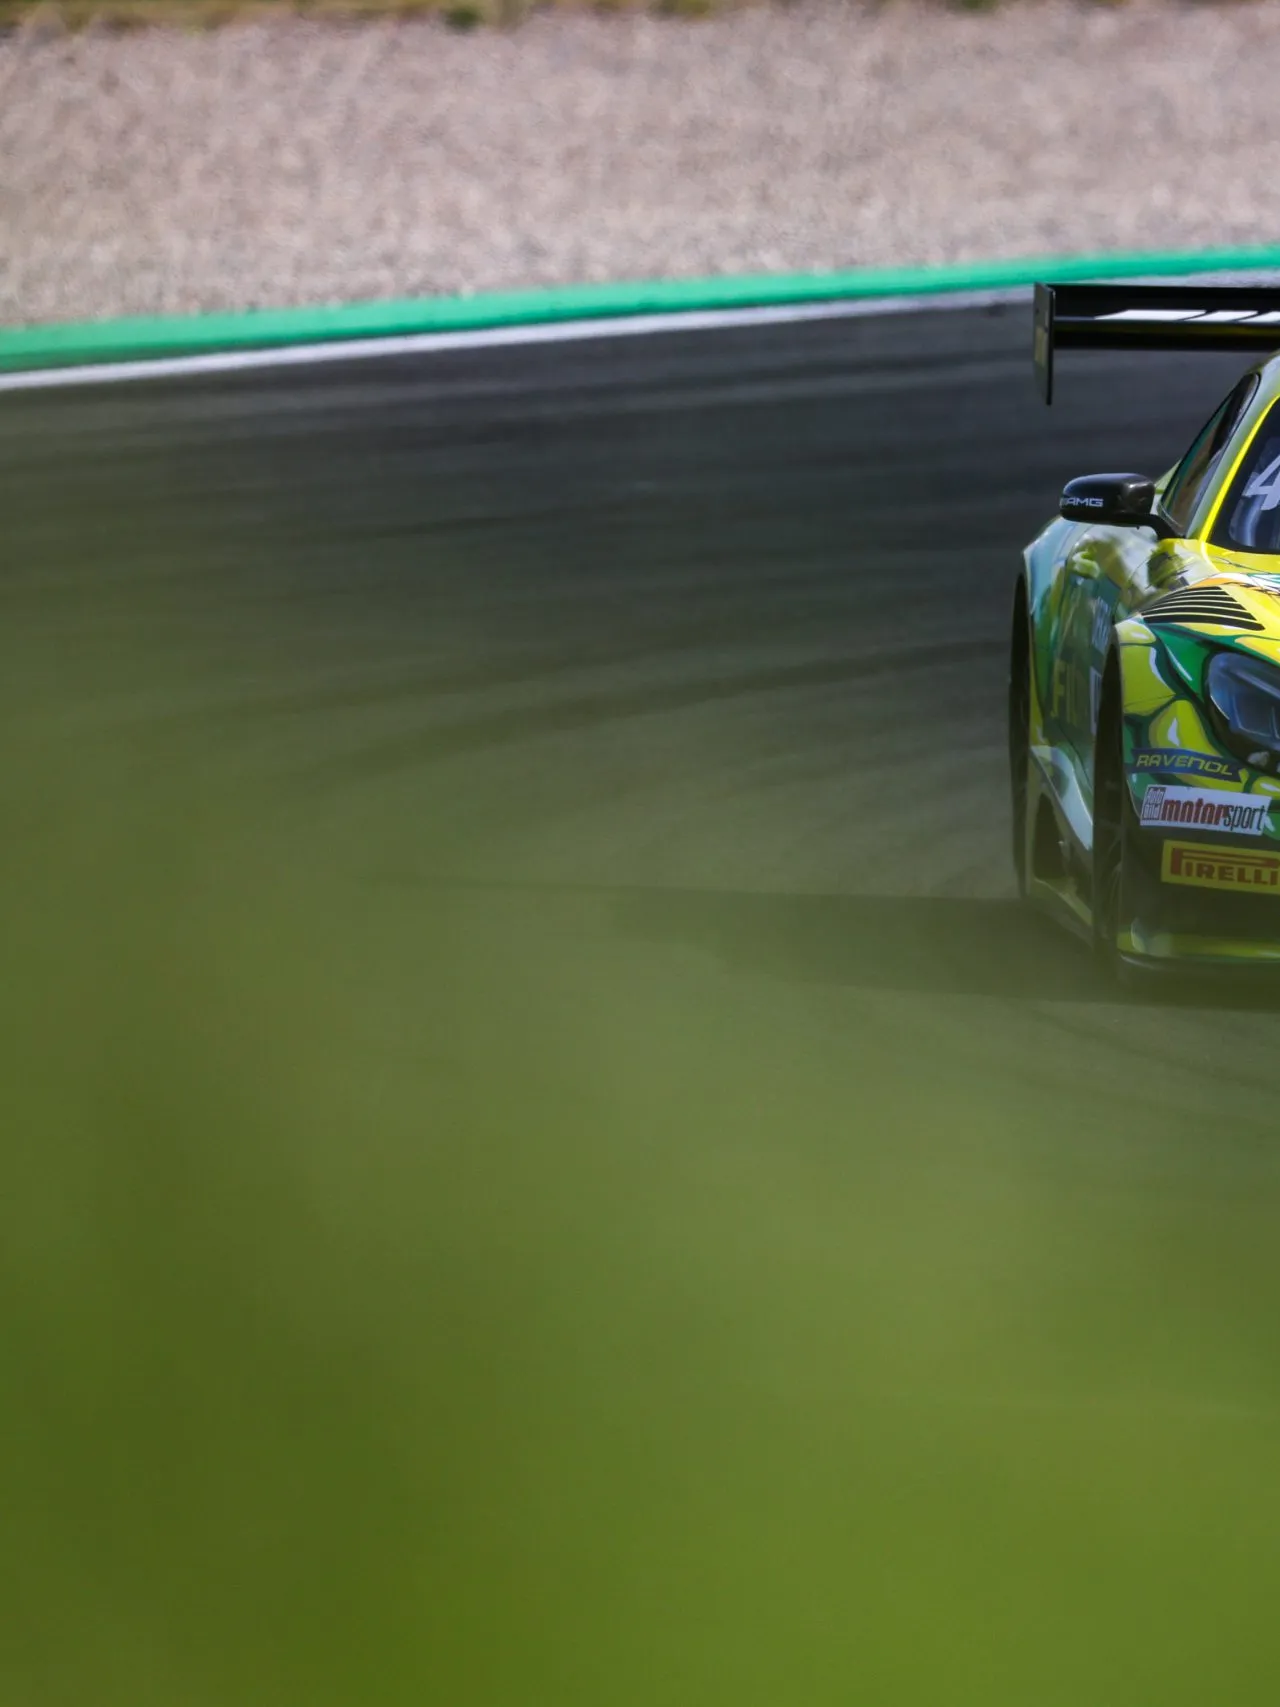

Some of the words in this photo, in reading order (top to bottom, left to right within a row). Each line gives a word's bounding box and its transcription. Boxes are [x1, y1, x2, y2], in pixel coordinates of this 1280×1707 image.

[1063, 497, 1104, 507] AMG
[1136, 754, 1233, 776] RAVENOL
[1161, 798, 1266, 831] motorsport
